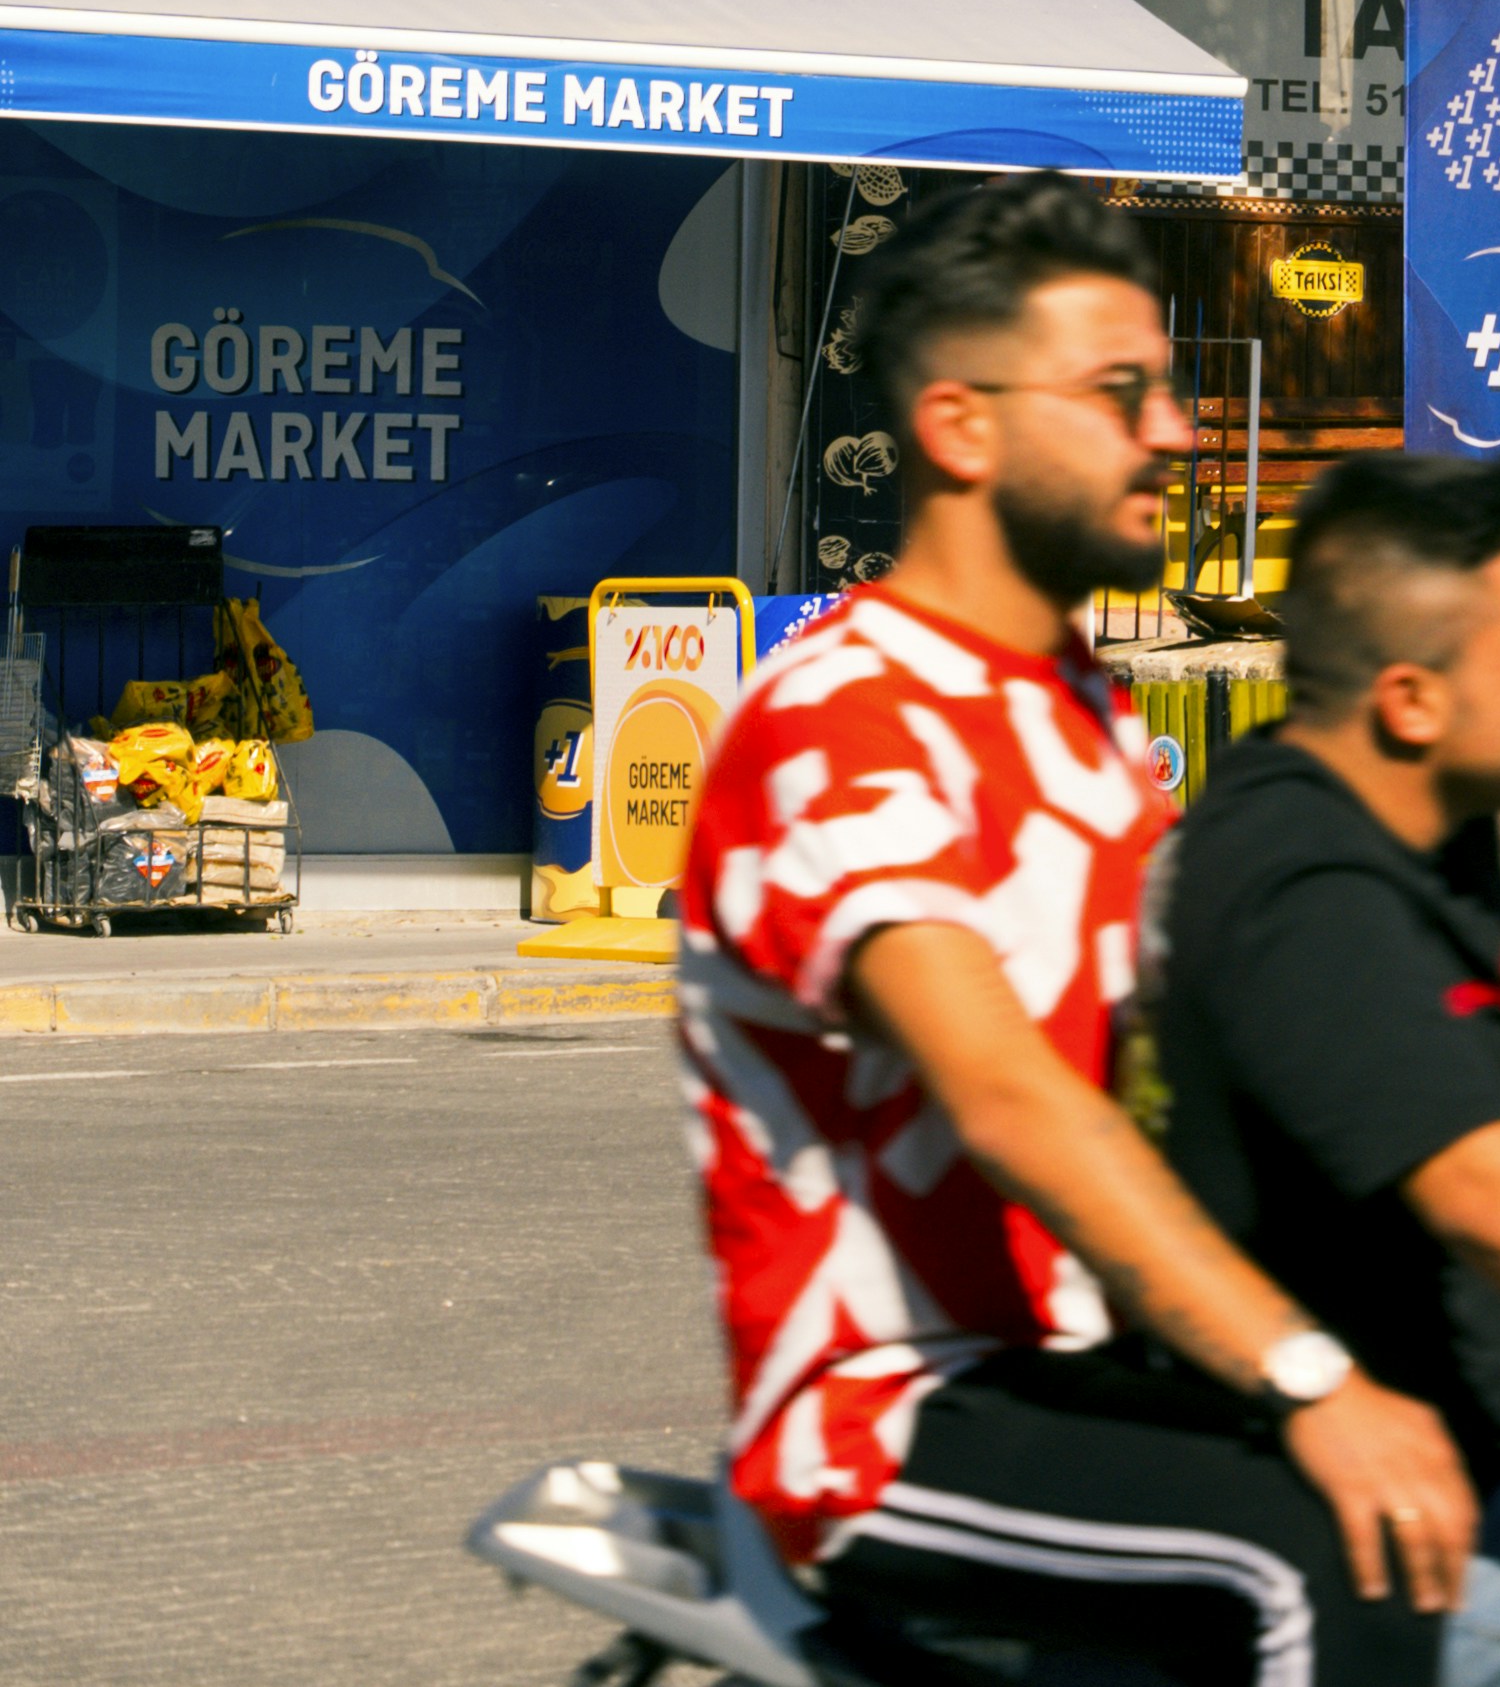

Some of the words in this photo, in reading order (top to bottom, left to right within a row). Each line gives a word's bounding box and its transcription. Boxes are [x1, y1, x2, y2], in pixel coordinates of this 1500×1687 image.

[1468, 58, 1498, 93] +1
[308, 49, 547, 124] GÖREME
[563, 73, 794, 139] MARKET
[1366, 83, 1405, 117] 51
[1446, 90, 1476, 125] +1
[1426, 121, 1455, 156] +1
[1465, 123, 1494, 158] +1
[1444, 154, 1474, 190] +1
[1295, 265, 1344, 292] TAKSİ
[150, 306, 466, 396] GÖREME
[153, 410, 462, 483] MARKET
[628, 756, 693, 790] GÖREME
[627, 799, 690, 827] MARKET
